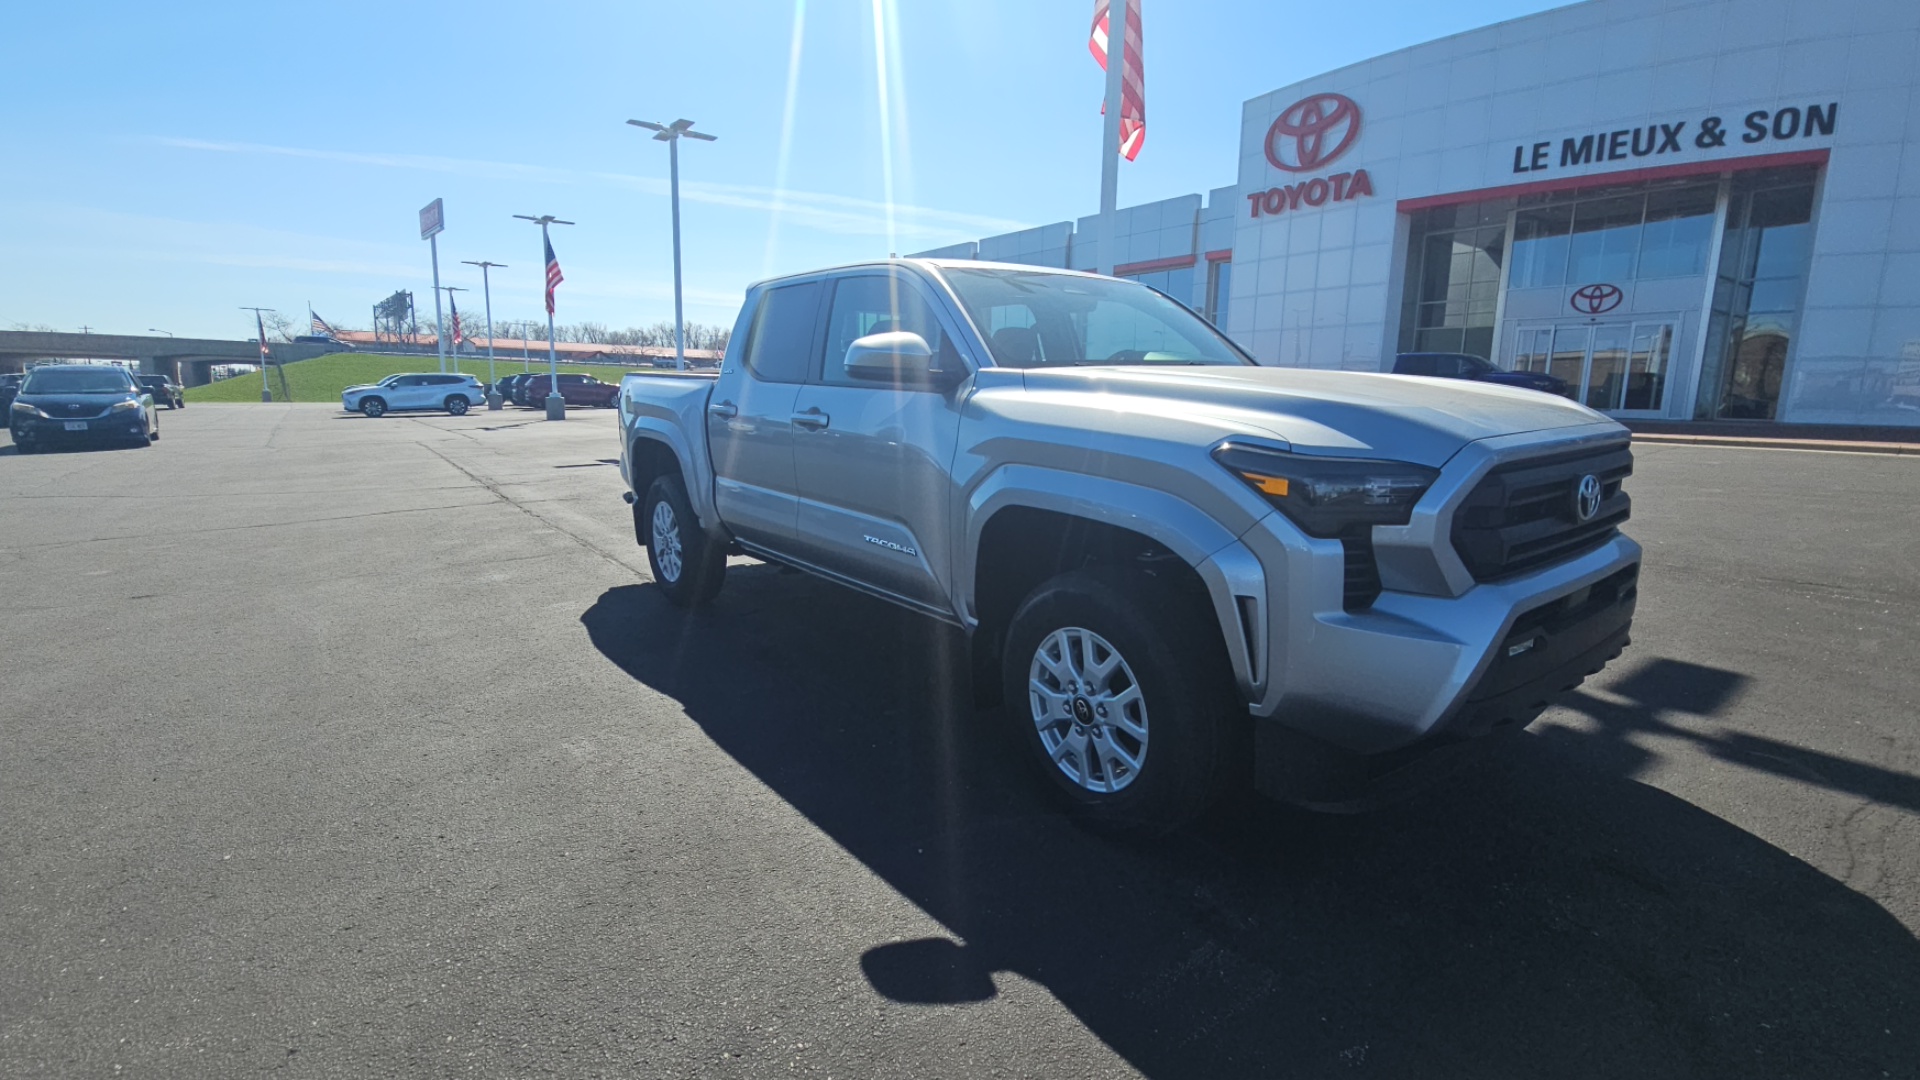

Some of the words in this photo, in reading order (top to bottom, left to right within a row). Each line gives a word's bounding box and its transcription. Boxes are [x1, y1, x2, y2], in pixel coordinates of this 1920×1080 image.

[1513, 141, 1550, 173] LE
[1560, 121, 1686, 167] MIEUX
[1695, 116, 1727, 148] &
[1742, 102, 1838, 144] SON
[1247, 168, 1373, 218] TOYOTA
